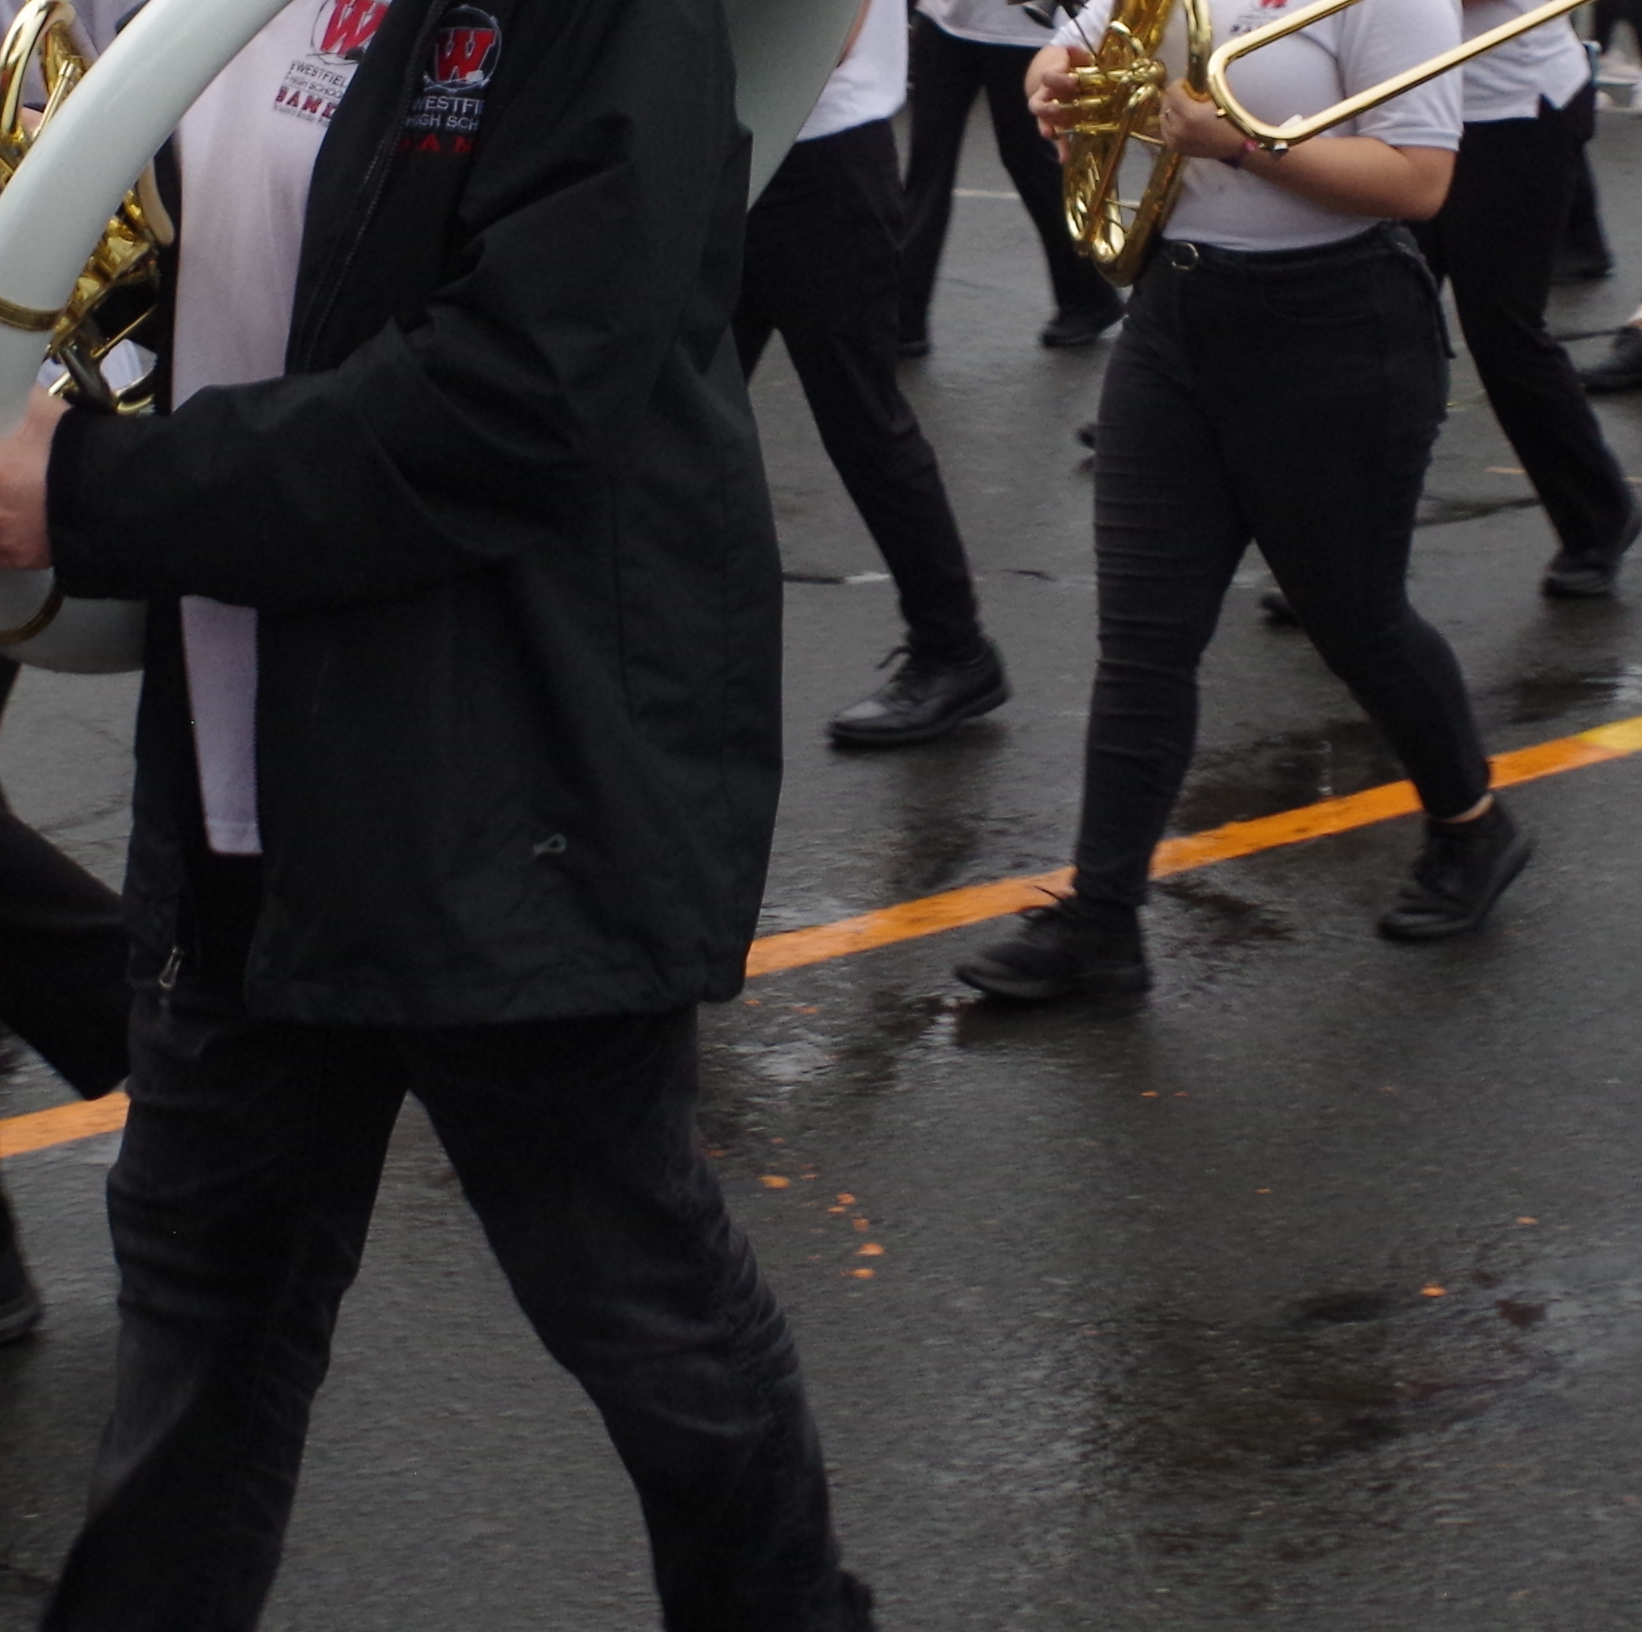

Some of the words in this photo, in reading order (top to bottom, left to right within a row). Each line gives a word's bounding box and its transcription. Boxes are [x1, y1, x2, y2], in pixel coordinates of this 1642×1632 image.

[433, 27, 498, 83] W
[296, 62, 348, 88] WESTFIEL
[309, 80, 344, 100] SCHOO
